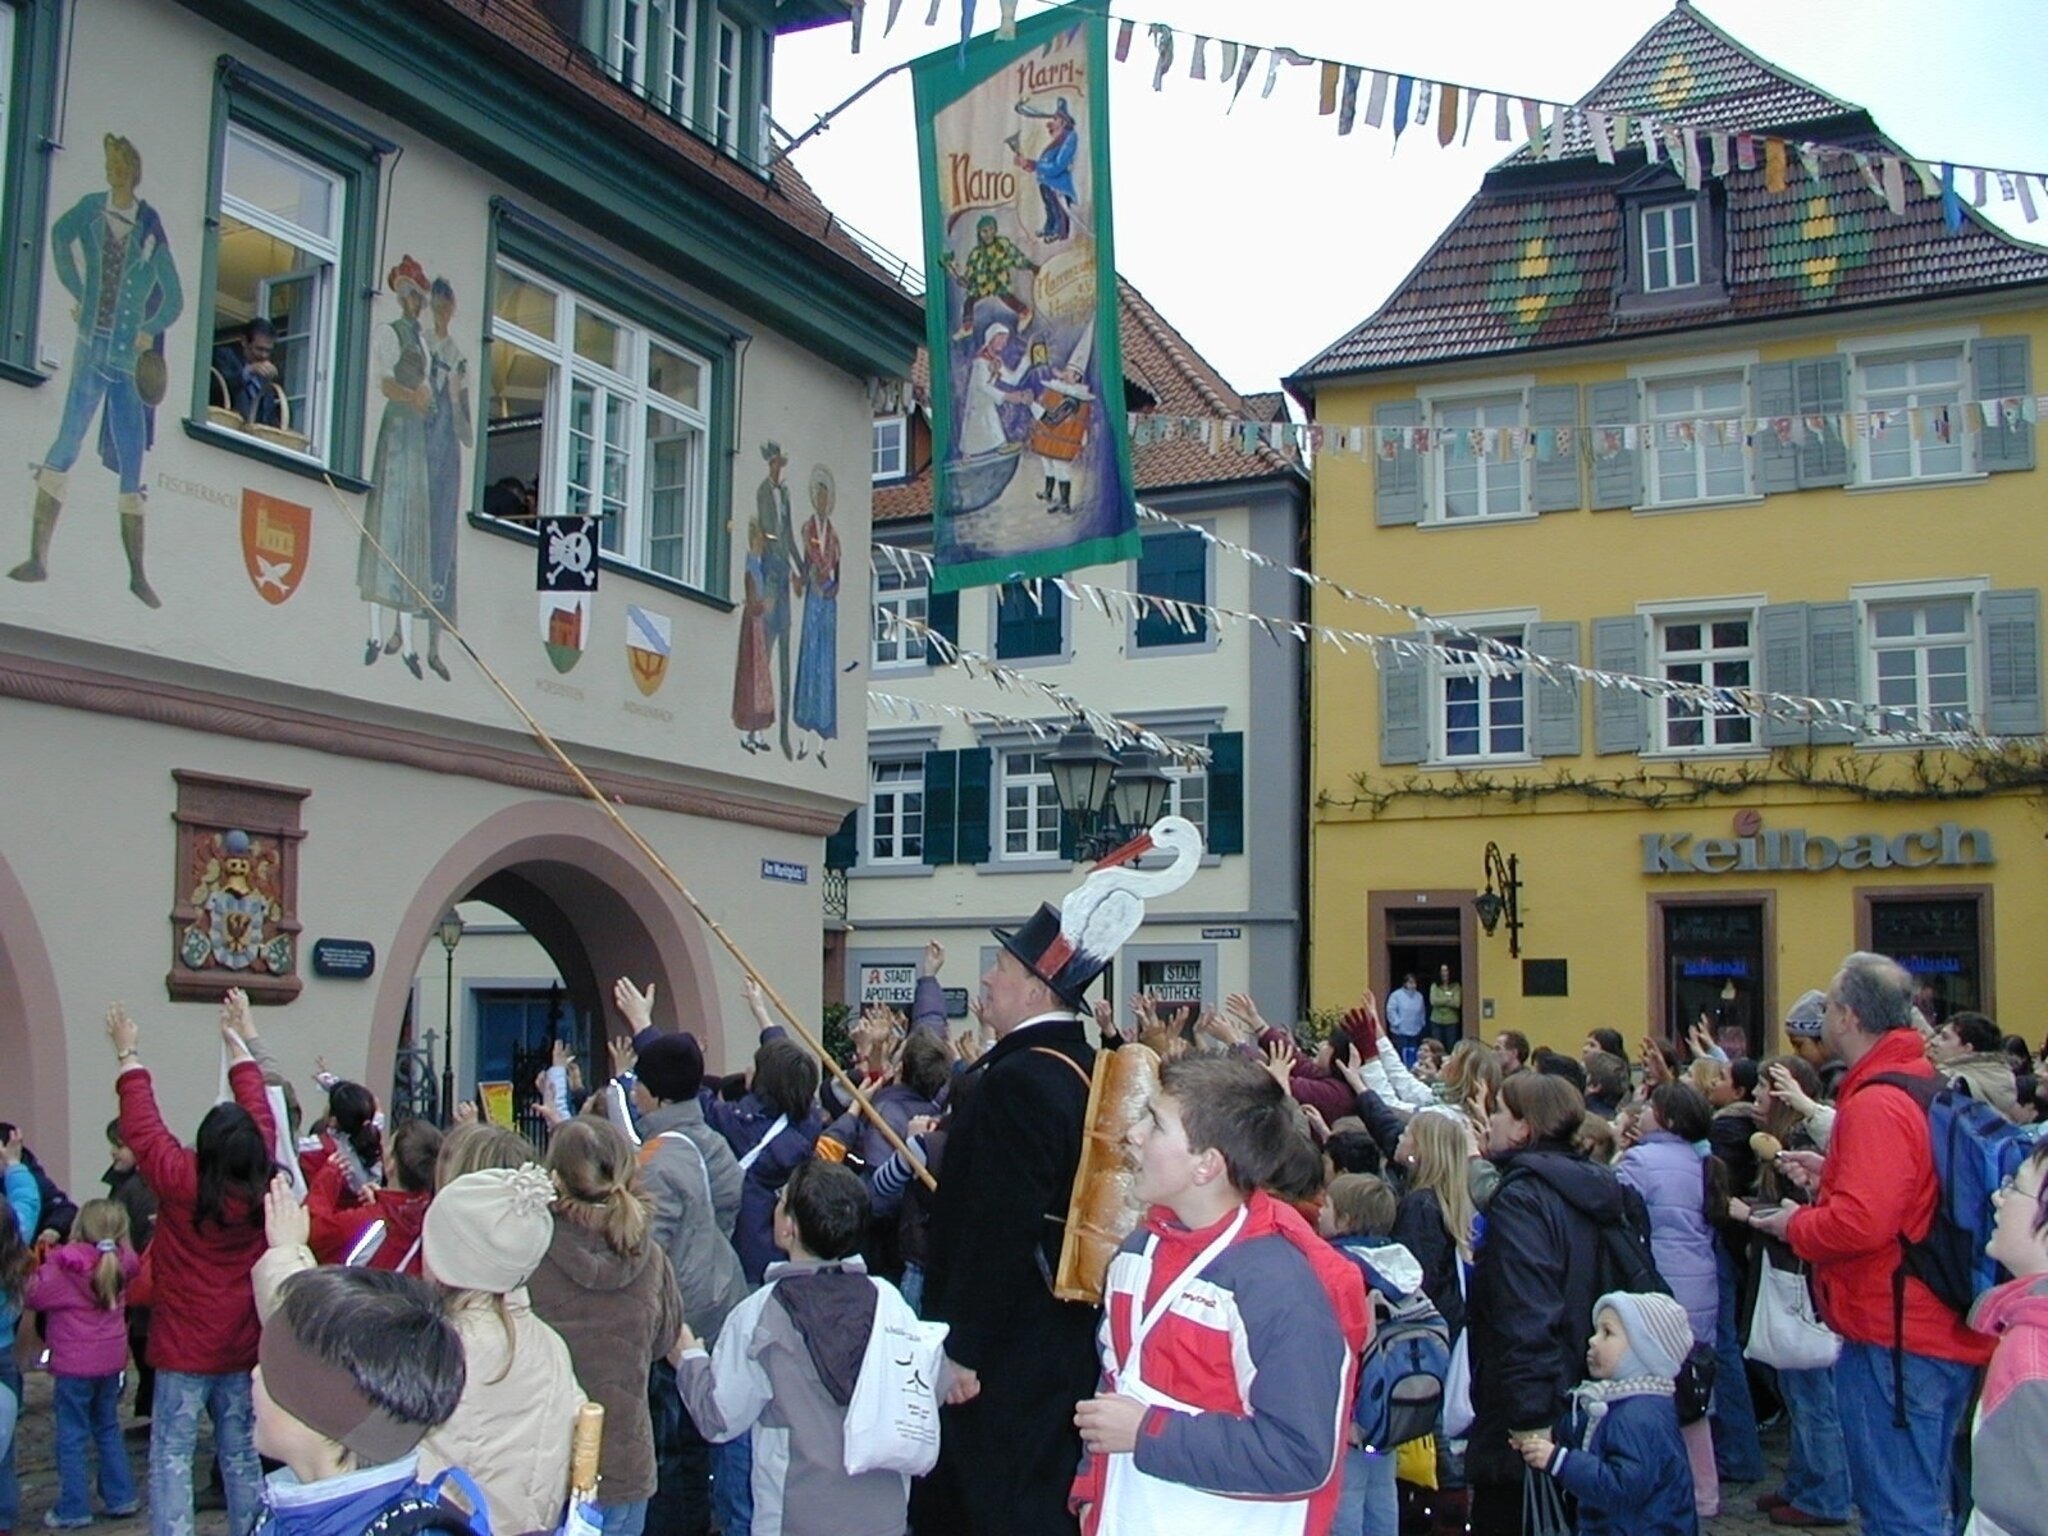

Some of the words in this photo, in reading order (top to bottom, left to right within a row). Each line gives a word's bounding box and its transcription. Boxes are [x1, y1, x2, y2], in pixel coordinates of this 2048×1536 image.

[948, 153, 1014, 208] Narro
[1639, 808, 1997, 875] Keilbach
[884, 970, 912, 983] STADT
[1167, 964, 1201, 980] STADT
[865, 987, 913, 1001] APOTHEKE
